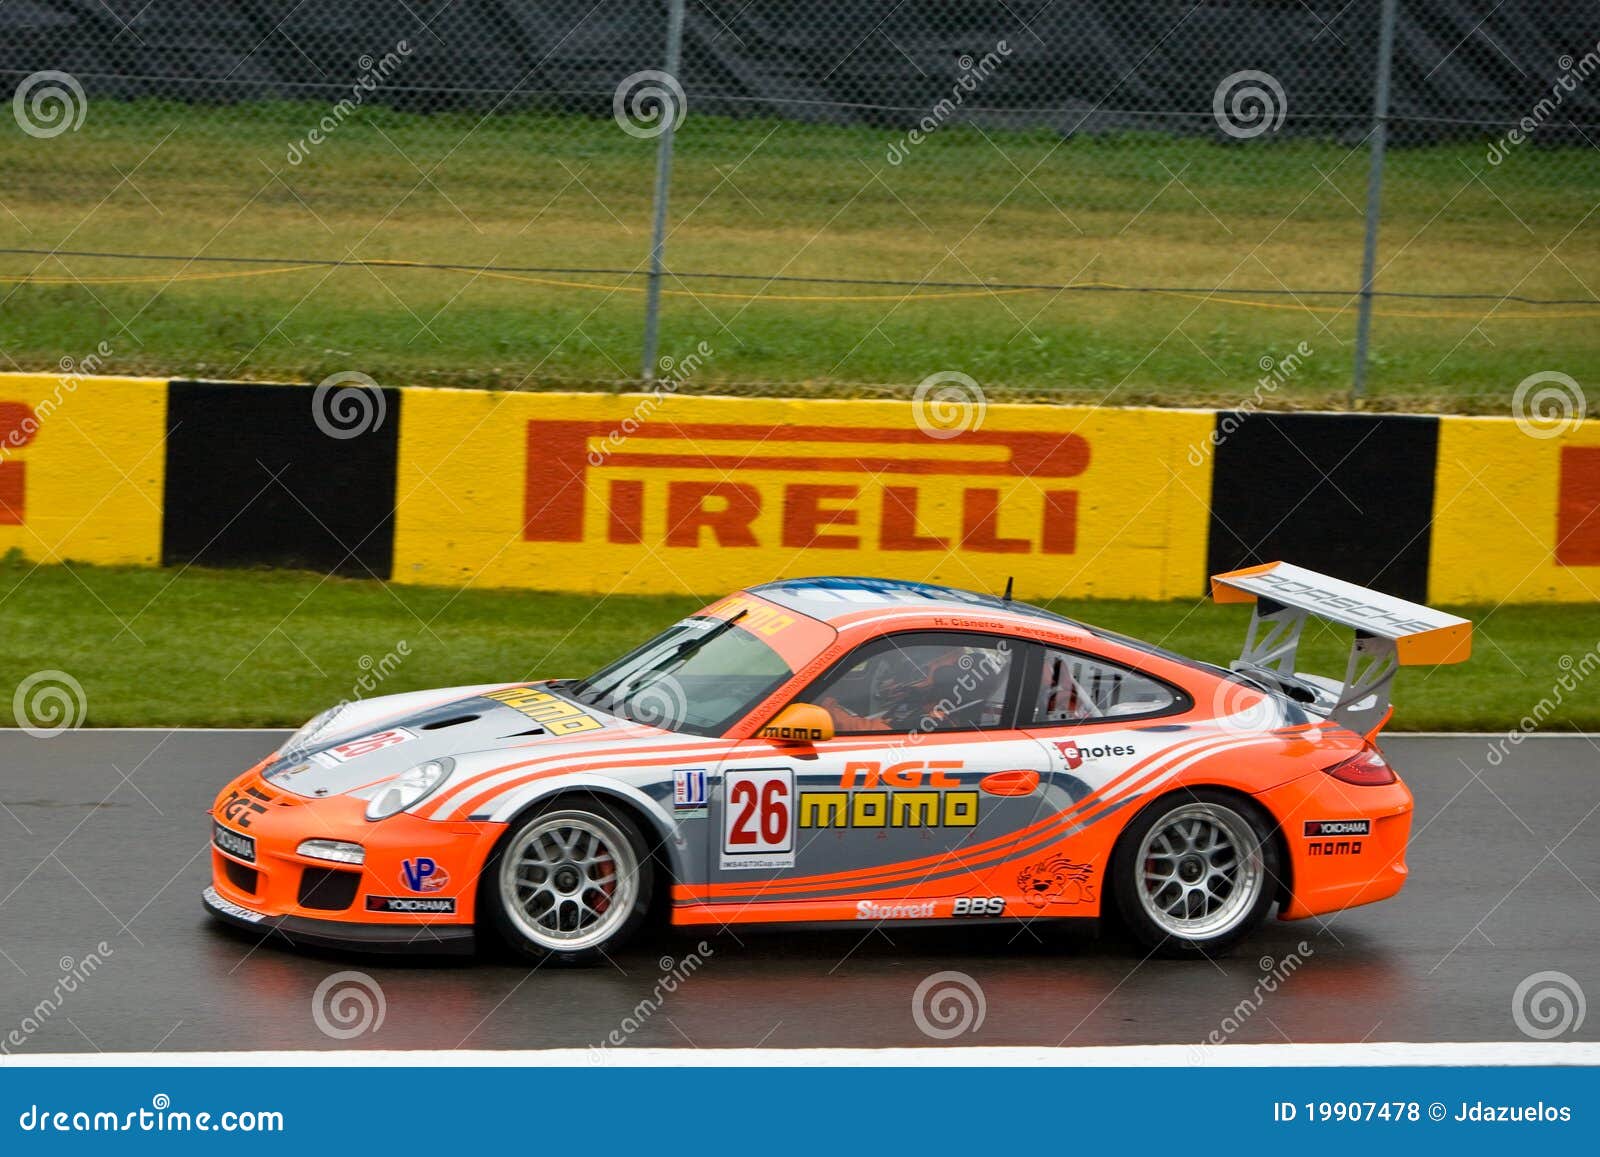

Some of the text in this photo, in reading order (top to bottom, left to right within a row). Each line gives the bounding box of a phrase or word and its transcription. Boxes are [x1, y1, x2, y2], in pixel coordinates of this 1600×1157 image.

[523, 420, 1091, 555] PIRELLI
[1247, 573, 1440, 633] PORSCHE
[764, 727, 822, 740] momo
[1063, 744, 1135, 759] enotes
[729, 779, 788, 845] 26
[798, 790, 980, 829] momo
[1320, 822, 1367, 834] YOKOHAMA
[1308, 841, 1362, 856] momo
[402, 857, 436, 892] VP
[388, 899, 453, 911] YOKOHAMA
[856, 900, 937, 920] Starrett
[952, 897, 1006, 916] BBS
